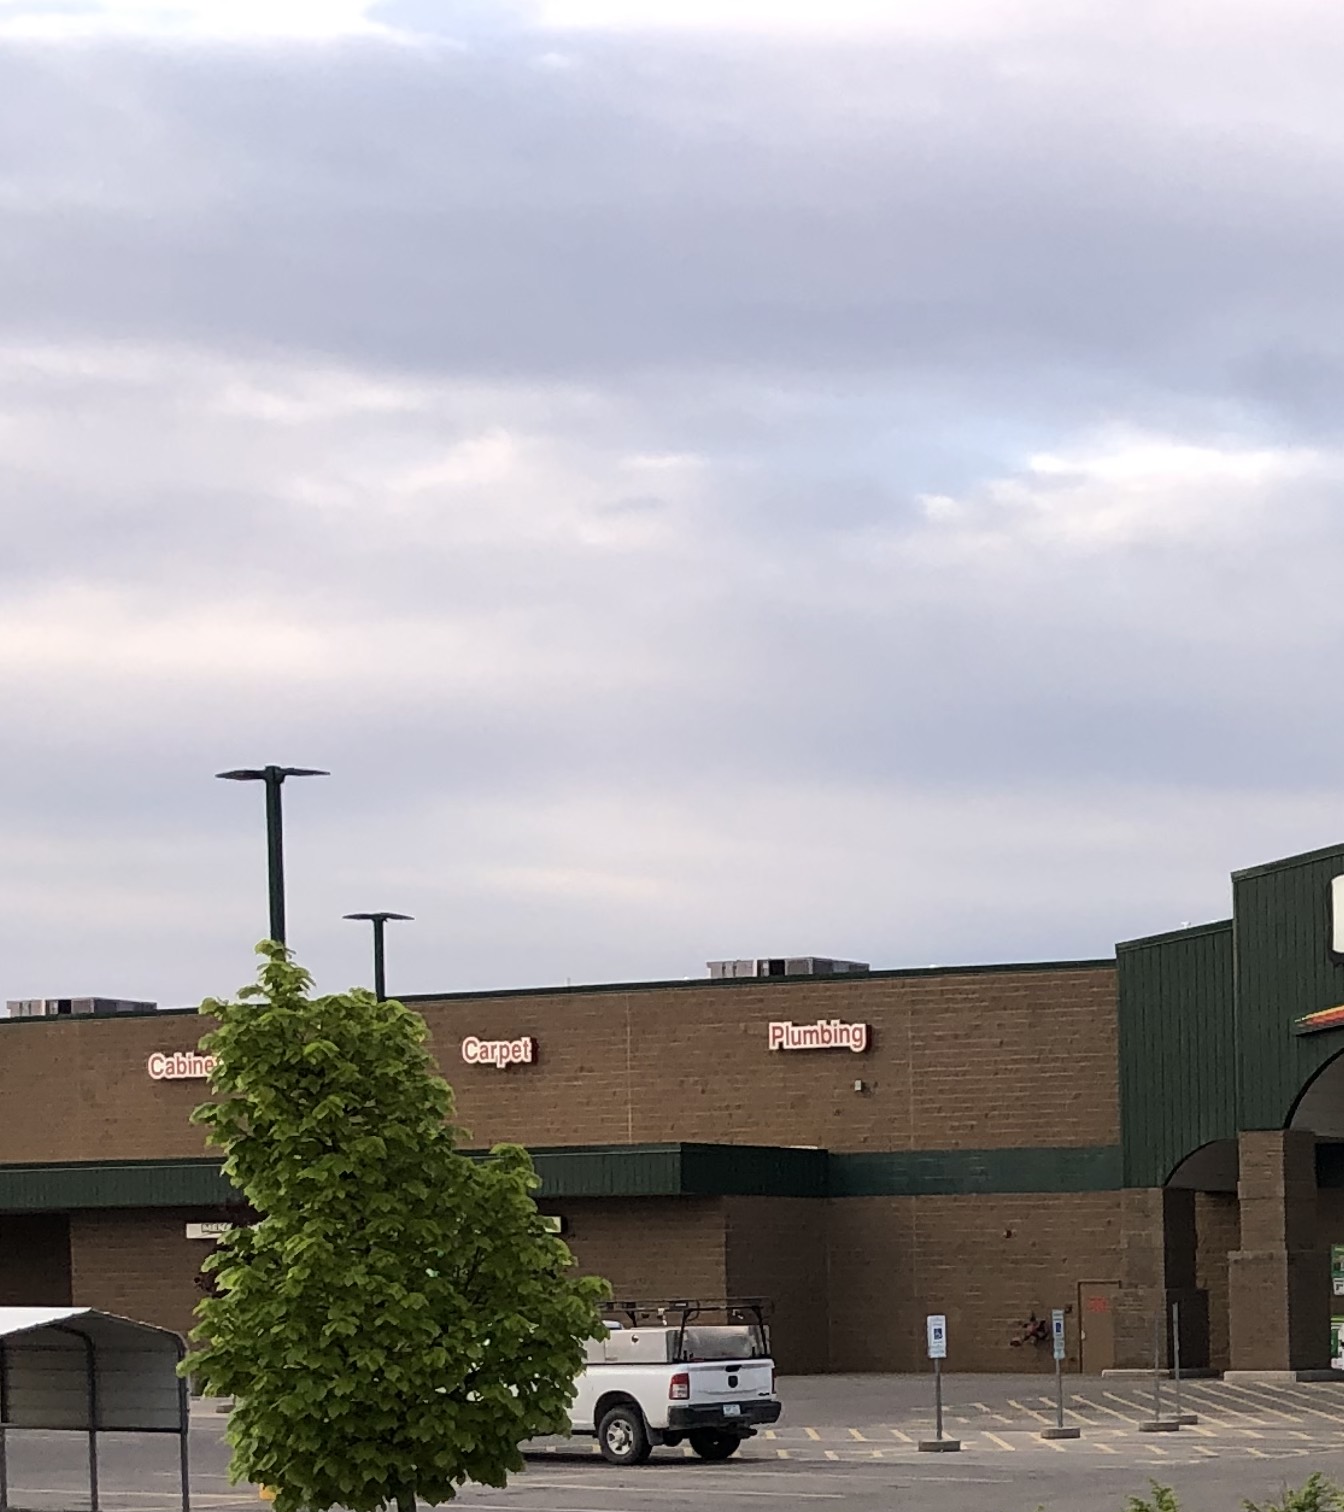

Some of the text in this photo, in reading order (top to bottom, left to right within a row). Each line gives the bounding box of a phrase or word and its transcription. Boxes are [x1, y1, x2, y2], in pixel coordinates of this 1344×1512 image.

[769, 1019, 866, 1052] Plumbing
[148, 1052, 218, 1079] Cabine
[462, 1036, 532, 1068] Carpet
